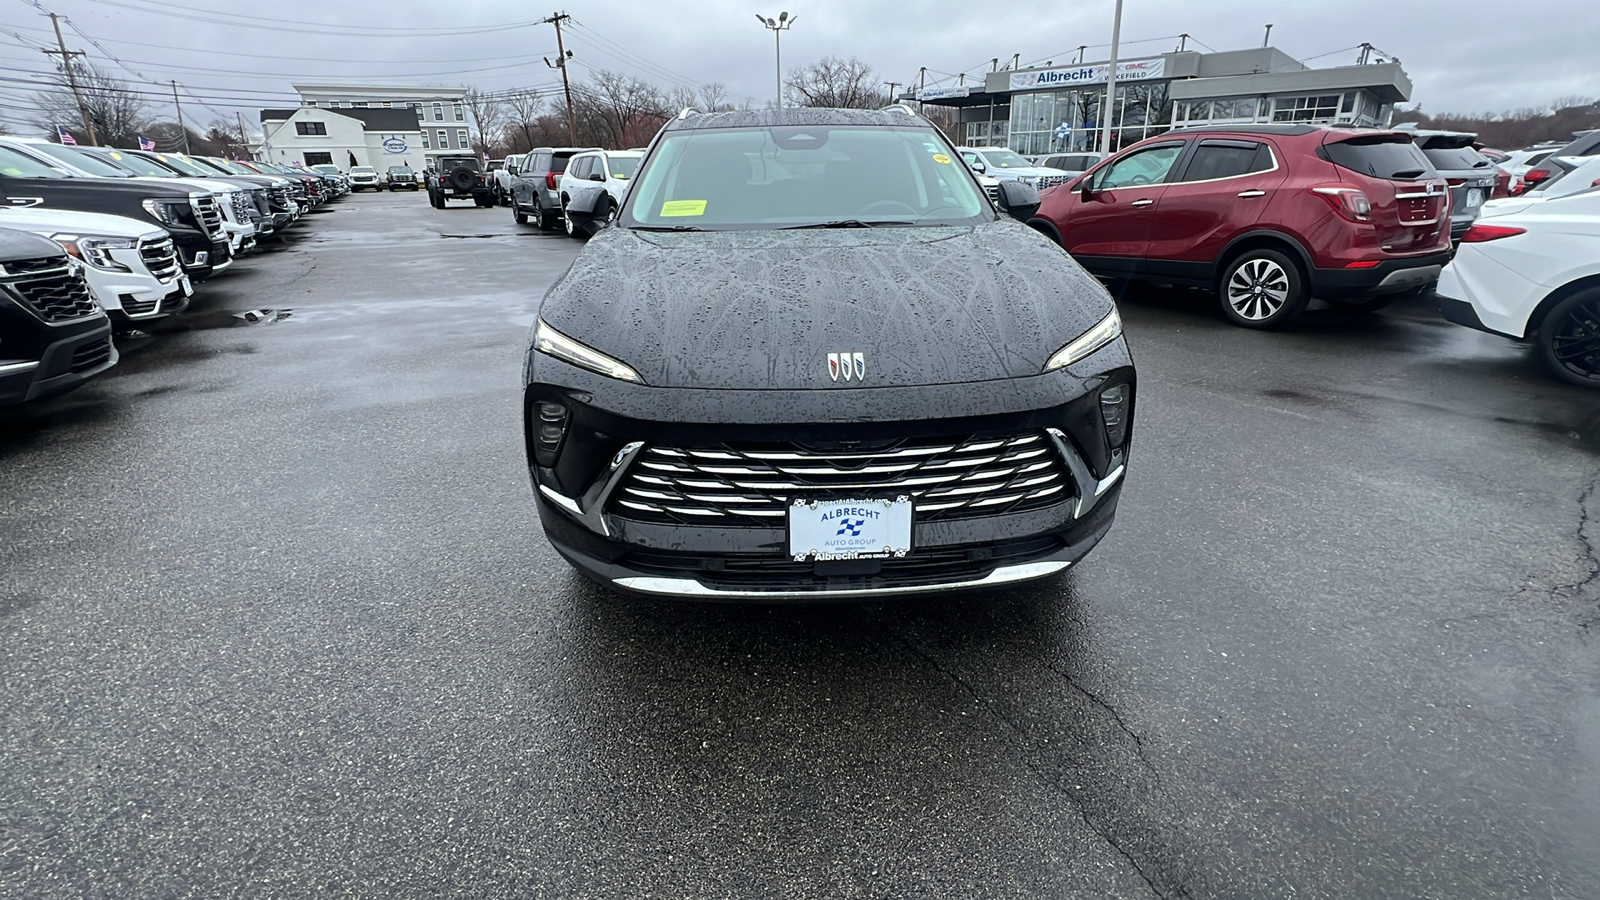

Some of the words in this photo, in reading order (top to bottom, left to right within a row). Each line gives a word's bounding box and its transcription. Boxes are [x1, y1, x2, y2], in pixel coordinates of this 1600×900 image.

[1125, 62, 1147, 70] GMC
[1037, 68, 1093, 83] Albrecht
[1104, 72, 1147, 81] WKEFIELD
[821, 507, 880, 522] ALBRECHT
[814, 550, 859, 561] Albrecht
